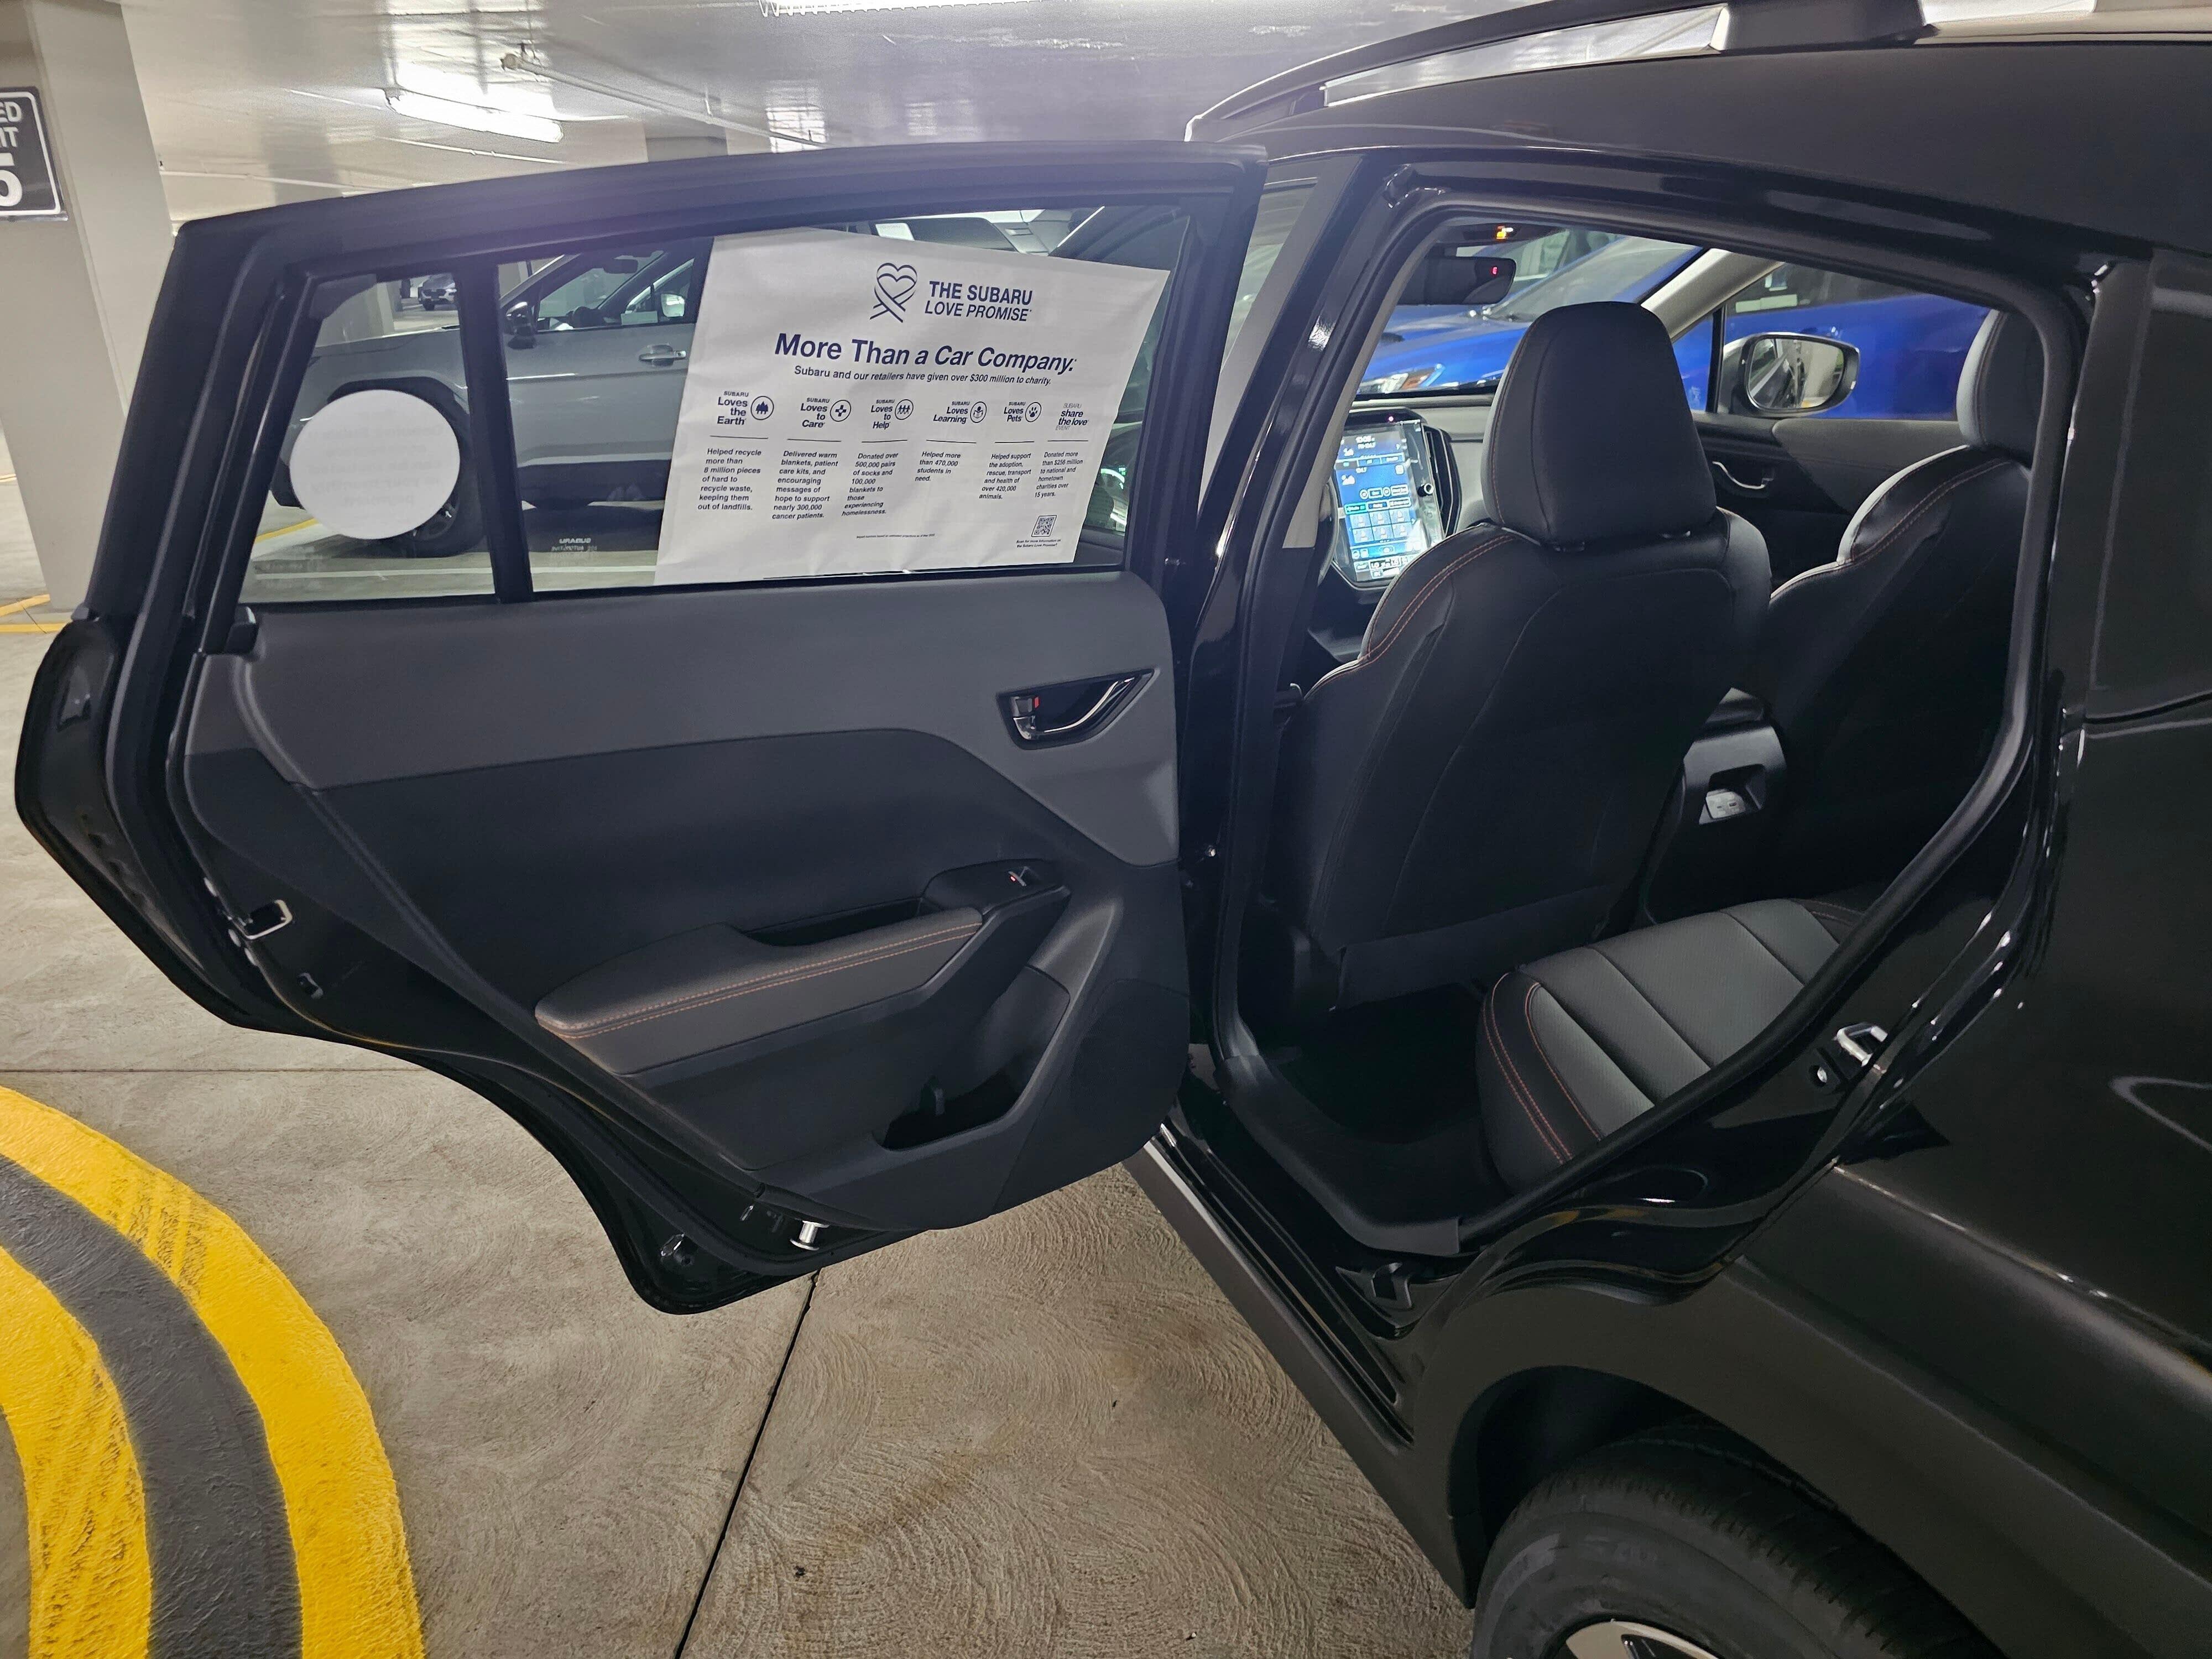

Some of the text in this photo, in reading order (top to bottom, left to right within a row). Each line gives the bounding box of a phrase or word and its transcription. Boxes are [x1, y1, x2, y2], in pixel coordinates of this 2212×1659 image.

[930, 281, 1032, 306] THE SUBARU
[925, 300, 1031, 321] LOVE PROMISE
[775, 333, 841, 359] More
[852, 339, 910, 364] Than
[915, 351, 928, 364] a
[935, 346, 974, 366] Car
[795, 366, 830, 377] Subaru
[833, 371, 851, 379] and
[870, 372, 904, 380] retailers
[927, 373, 948, 382] given
[970, 374, 988, 382] $300
[1025, 377, 1051, 386] charity.
[718, 397, 748, 407] Loves
[731, 408, 746, 416] the
[801, 403, 827, 412] Loves
[717, 416, 746, 425] Earth
[933, 415, 968, 424] Learning
[873, 421, 891, 430] Help
[880, 461, 895, 469] pairs
[737, 467, 760, 475] pieces
